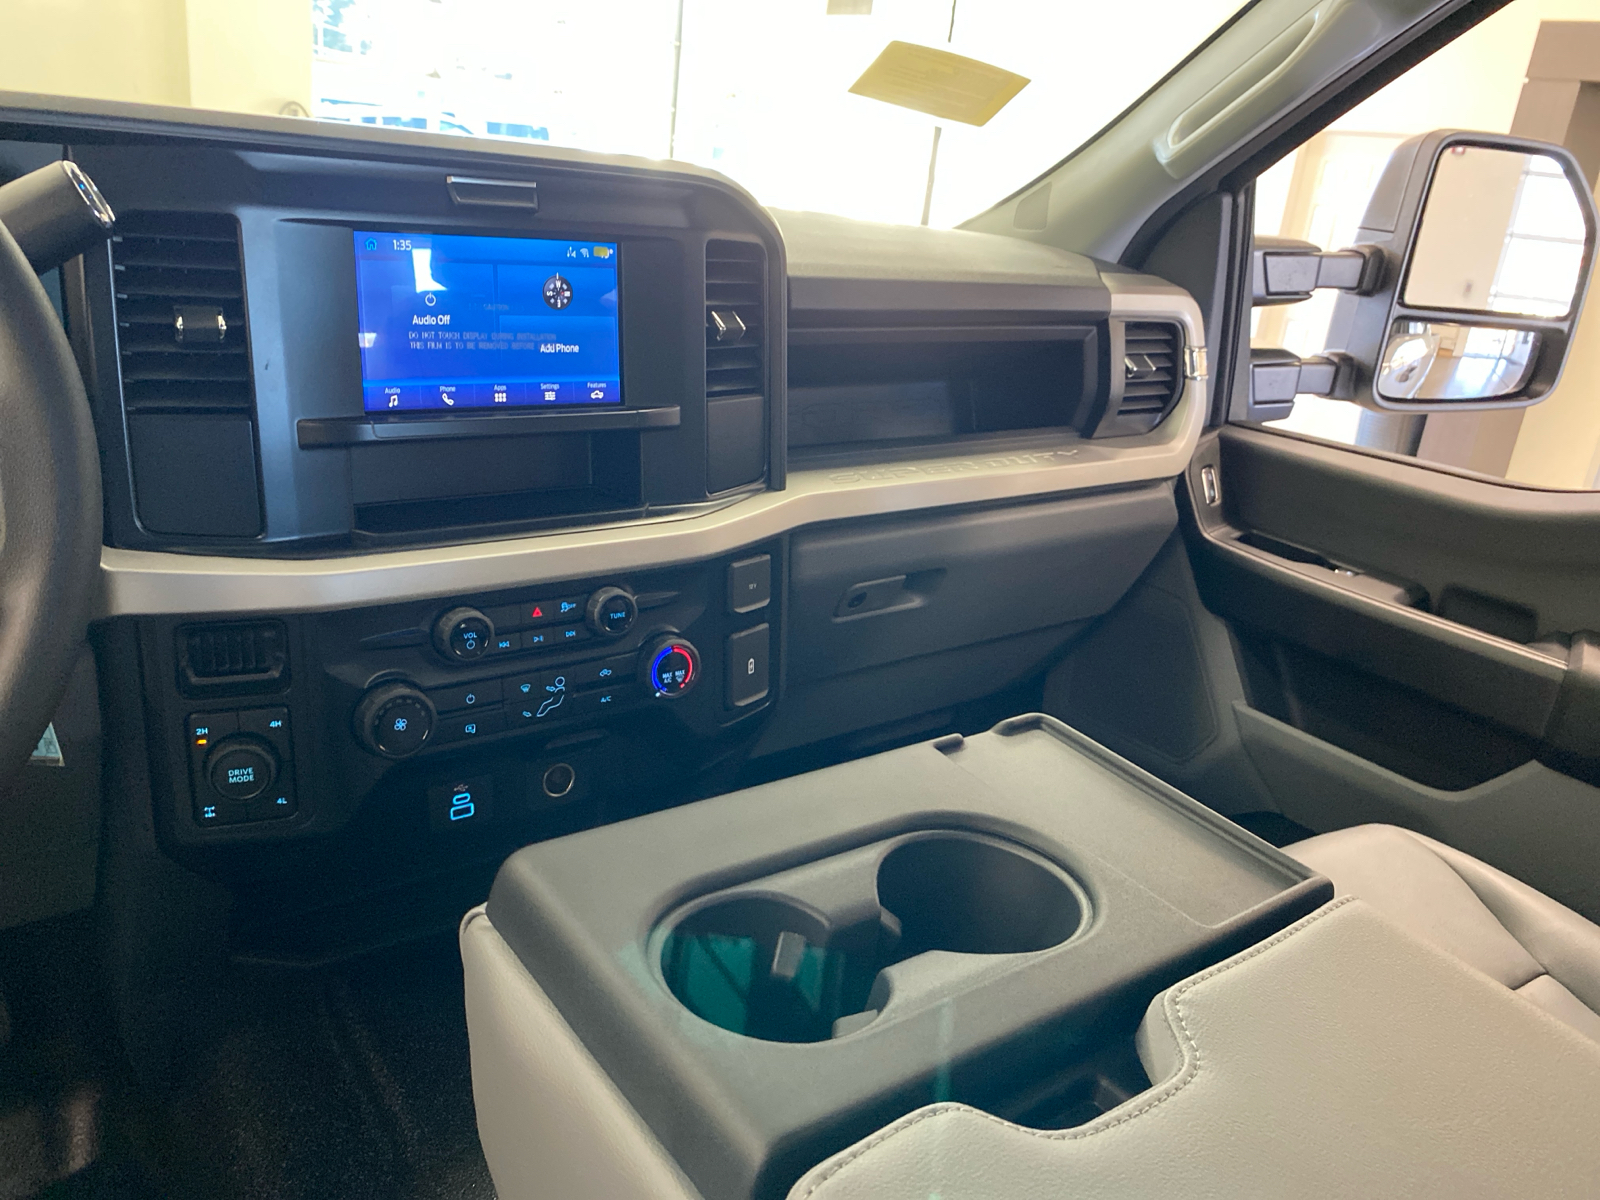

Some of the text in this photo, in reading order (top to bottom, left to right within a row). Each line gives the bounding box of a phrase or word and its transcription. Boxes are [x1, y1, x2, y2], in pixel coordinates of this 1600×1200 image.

[393, 239, 412, 251] 1:35
[412, 314, 451, 325] Audio Off
[408, 331, 419, 340] DO
[421, 331, 435, 340] NOT
[438, 331, 460, 340] TOUCH
[463, 332, 488, 340] DISPLAY
[410, 341, 425, 350] THIS
[427, 341, 442, 350] FILM
[445, 341, 452, 350] IS
[455, 341, 464, 350] TO
[540, 343, 555, 353] Add
[556, 343, 580, 353] Phone
[439, 385, 456, 393] Phone
[494, 384, 507, 392] Apps
[540, 382, 560, 391] Settings
[587, 381, 607, 389] Features
[384, 387, 401, 395] Audio
[463, 631, 478, 639] VOL
[269, 720, 282, 728] 4H
[195, 727, 209, 736] 2H
[227, 766, 254, 777] DRIVE
[228, 774, 255, 784] MODE
